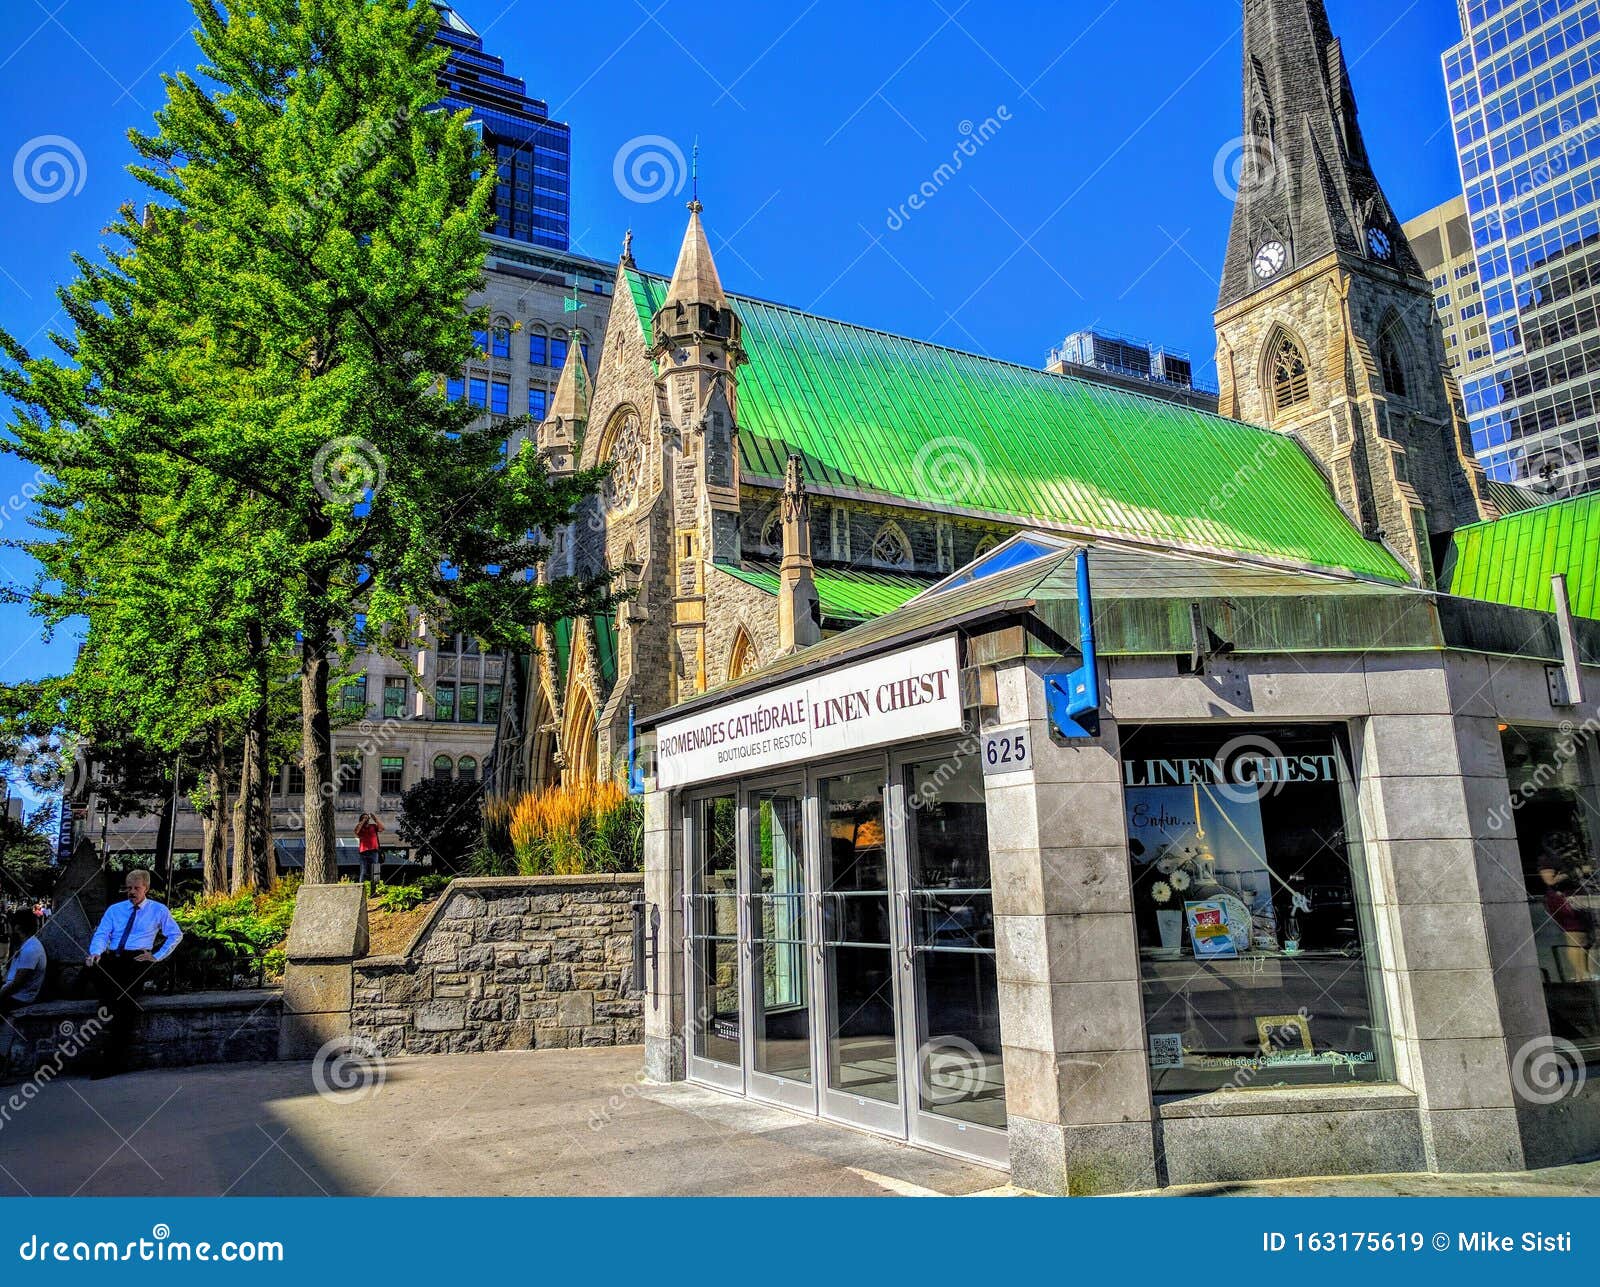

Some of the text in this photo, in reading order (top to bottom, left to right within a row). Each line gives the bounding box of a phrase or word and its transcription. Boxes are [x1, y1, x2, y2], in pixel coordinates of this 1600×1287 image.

[812, 668, 950, 730] LINEN CHEST
[660, 698, 806, 759] PROMENADES CATHÉDRALE
[717, 731, 807, 764] BOUTIQUES ET RESTOS
[986, 735, 1026, 765] 625
[1122, 755, 1338, 786] LINEN CHEST
[1345, 1051, 1374, 1062] McGill
